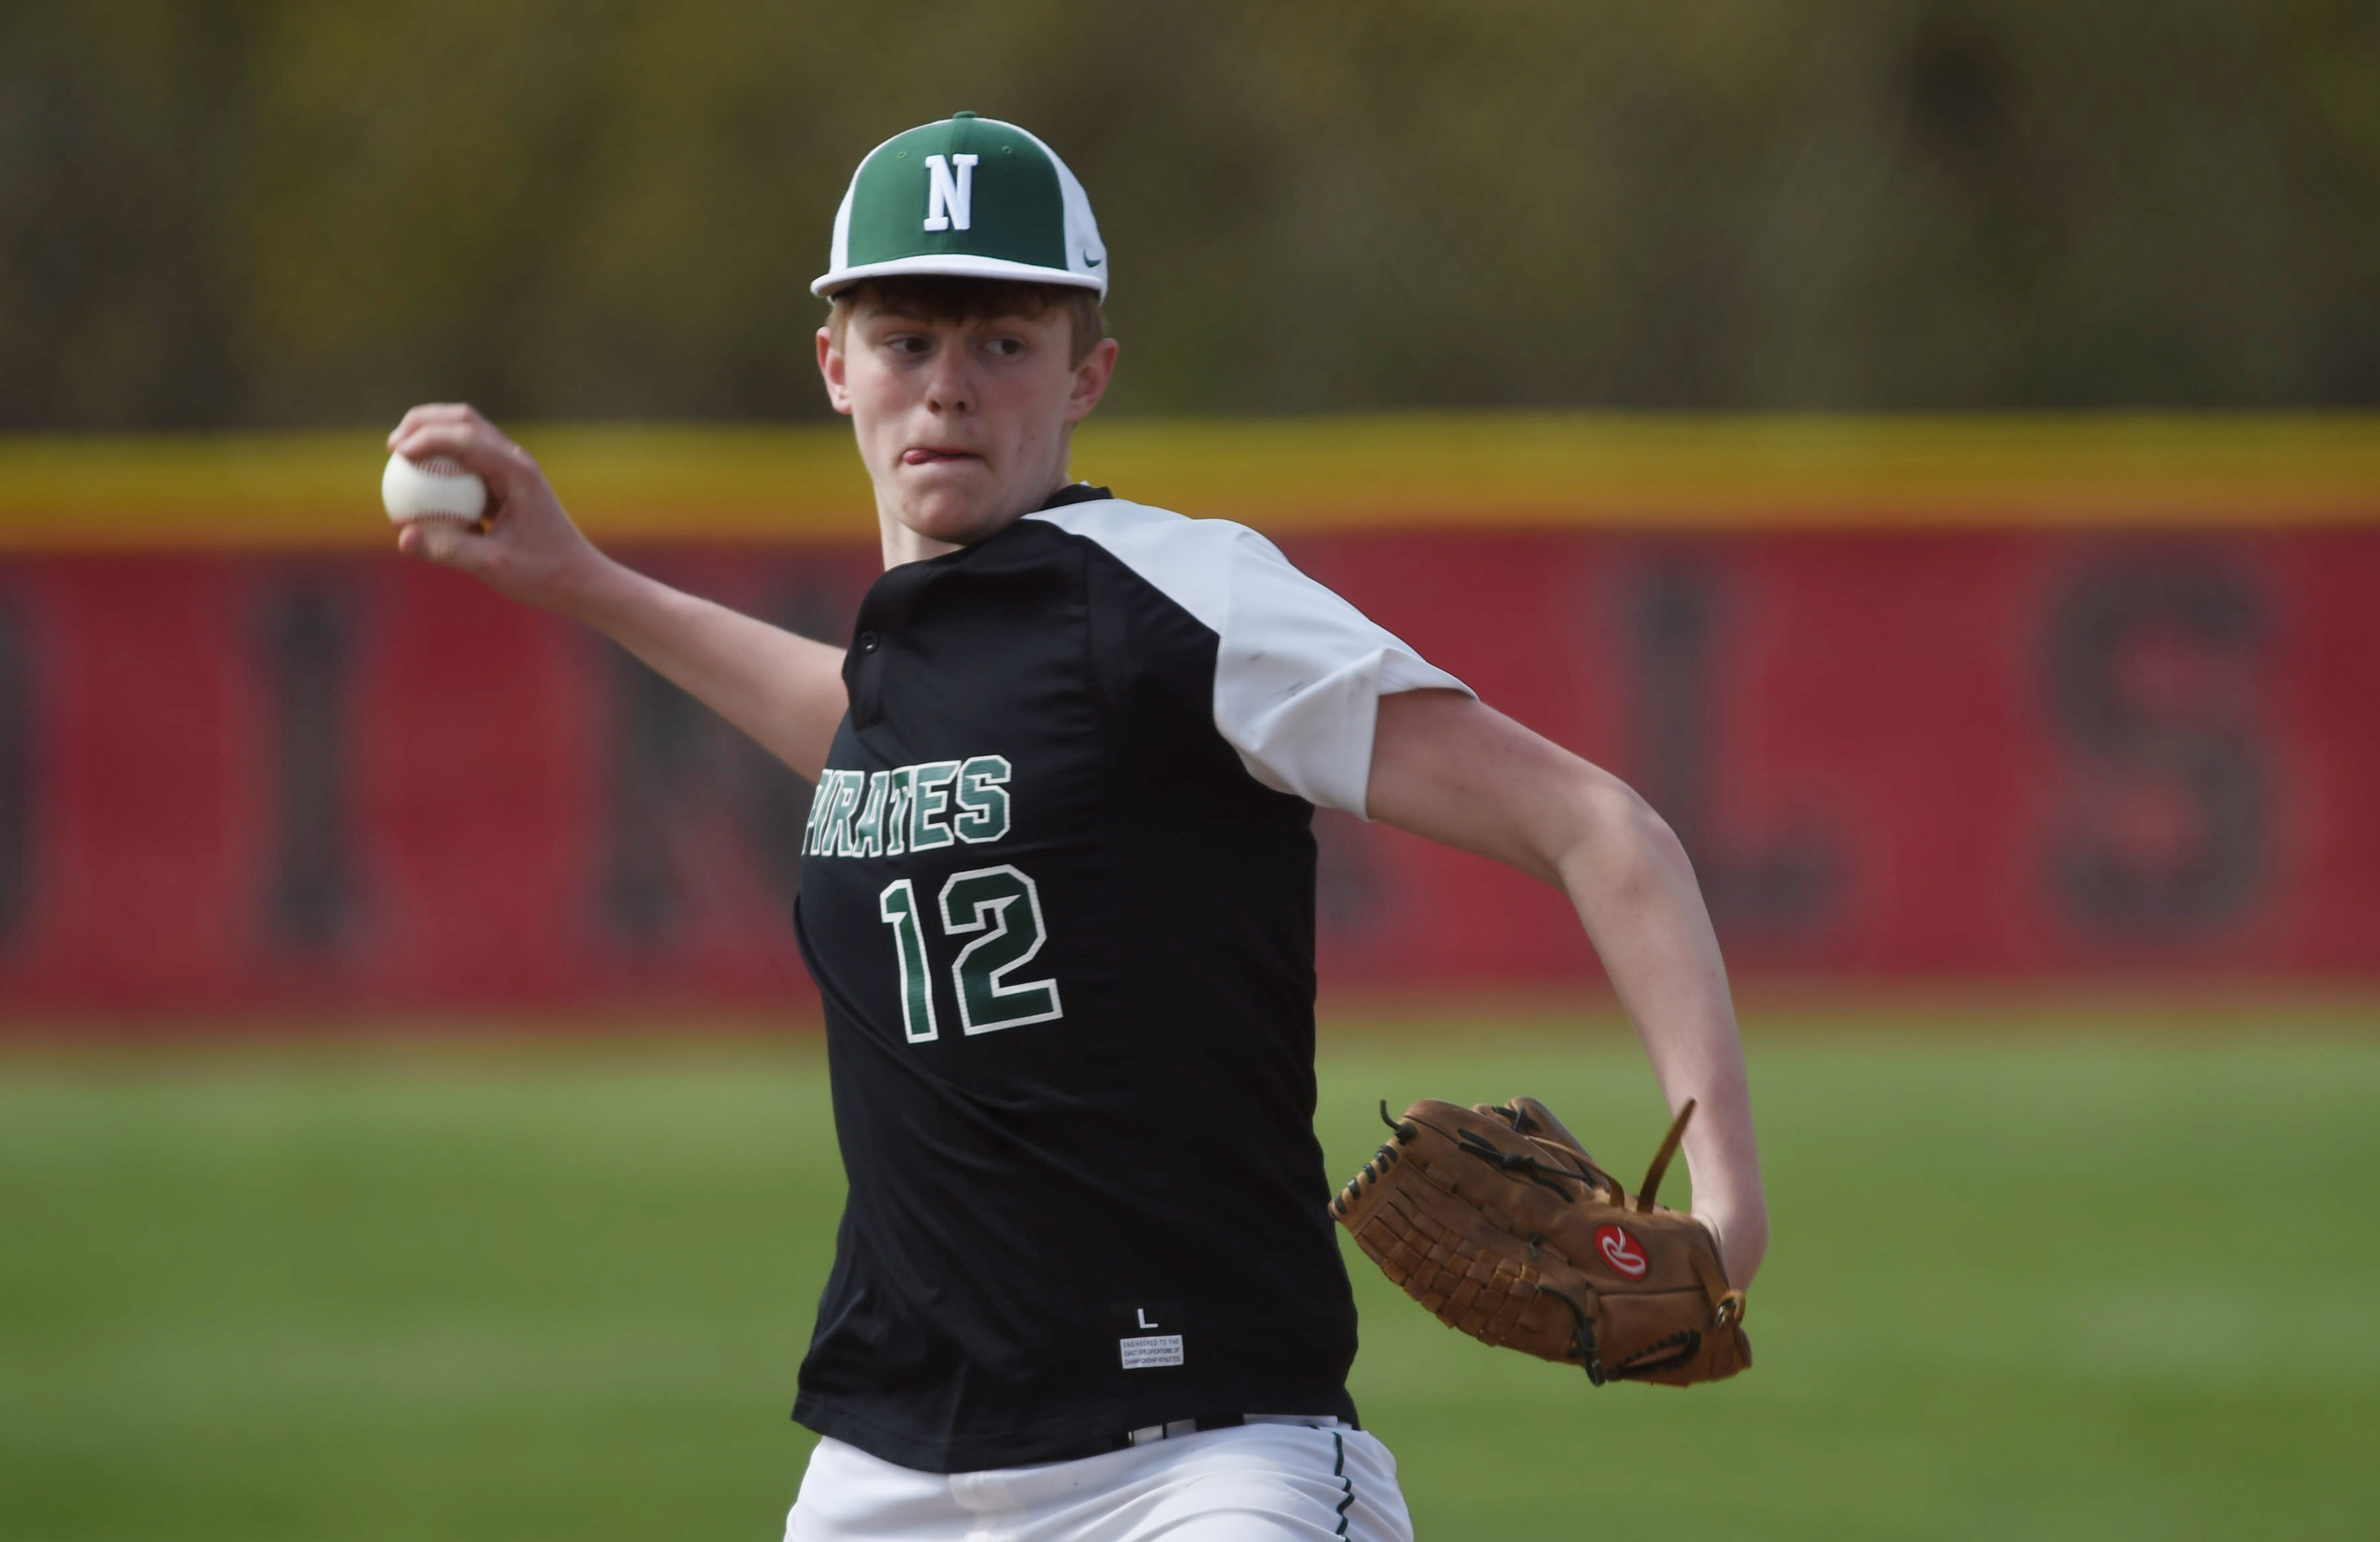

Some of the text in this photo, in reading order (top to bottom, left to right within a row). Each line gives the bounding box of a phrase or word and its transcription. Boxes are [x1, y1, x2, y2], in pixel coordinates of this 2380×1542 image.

[924, 154, 979, 232] N
[879, 863, 1063, 1044] 12
[1137, 1308, 1158, 1329] L
